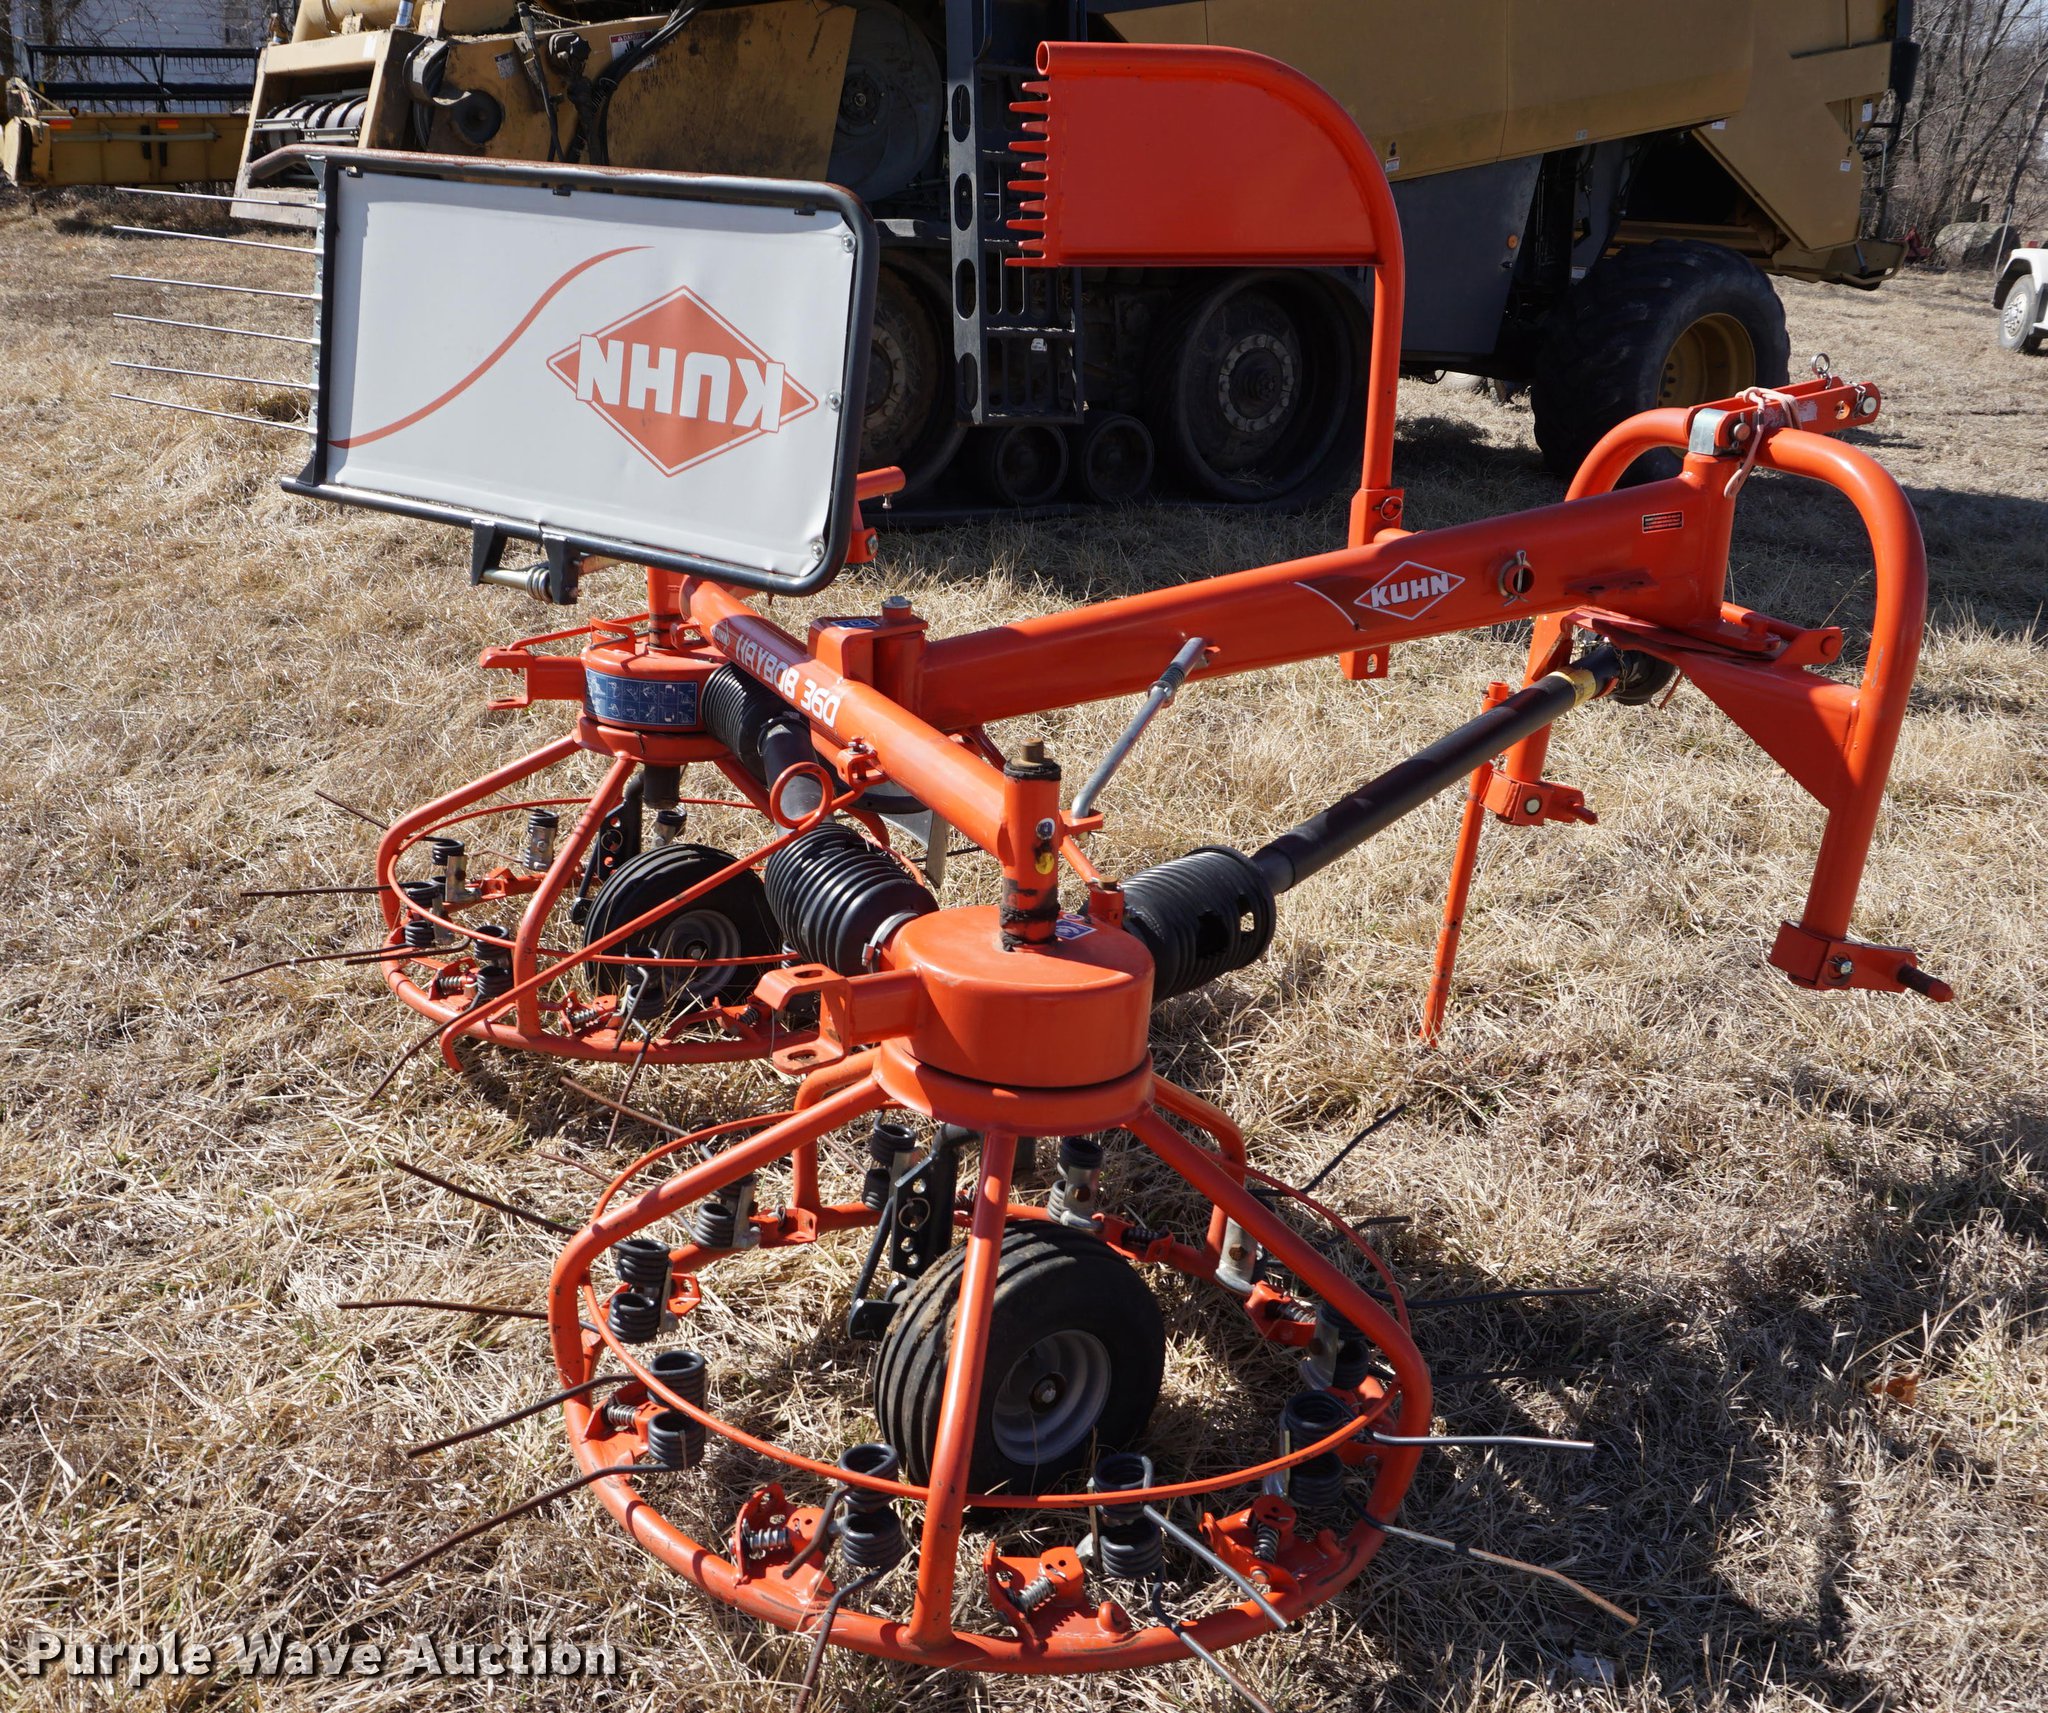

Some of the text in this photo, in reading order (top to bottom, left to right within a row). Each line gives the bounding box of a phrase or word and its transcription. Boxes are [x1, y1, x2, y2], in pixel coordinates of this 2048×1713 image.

[576, 334, 786, 433] KUHN
[1370, 573, 1450, 608] KUHN
[735, 634, 841, 728] HAYBOB 360
